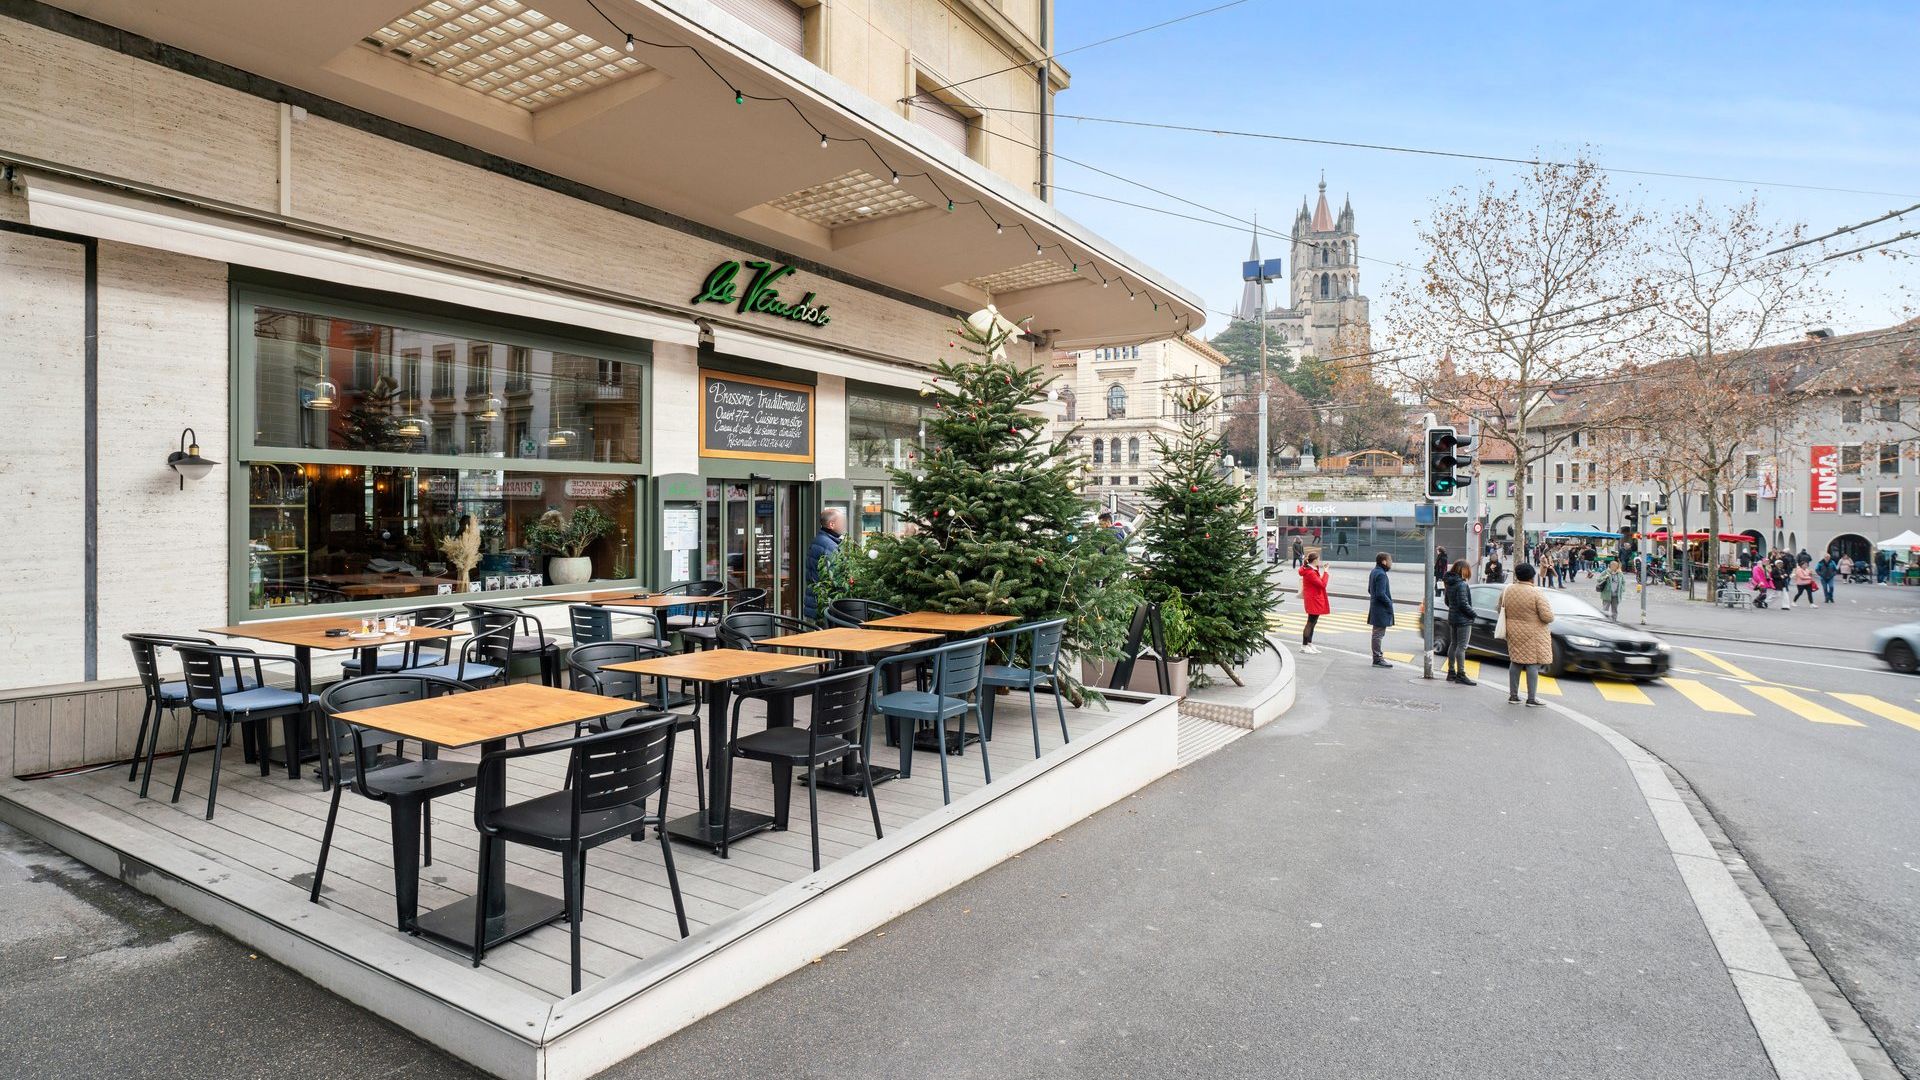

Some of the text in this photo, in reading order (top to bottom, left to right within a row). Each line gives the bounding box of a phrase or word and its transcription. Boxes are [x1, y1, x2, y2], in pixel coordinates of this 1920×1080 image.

[693, 260, 740, 305] le
[709, 382, 807, 413] Brasserie traditionnelle
[715, 406, 736, 421] Ouvert
[735, 408, 750, 423] 7/7
[754, 410, 780, 425] Cuisine
[1304, 503, 1337, 514] kiosk
[1448, 505, 1468, 514] BCV
